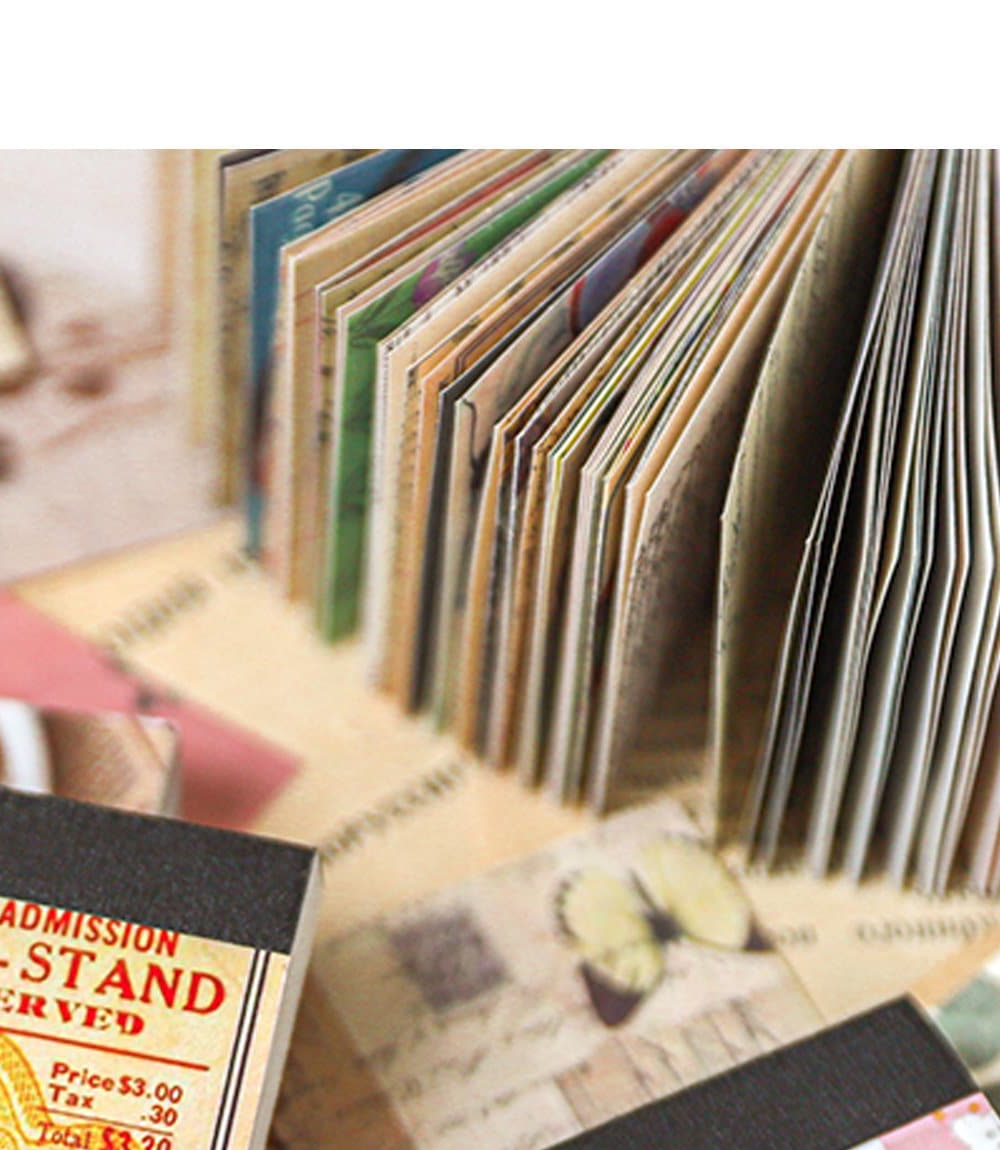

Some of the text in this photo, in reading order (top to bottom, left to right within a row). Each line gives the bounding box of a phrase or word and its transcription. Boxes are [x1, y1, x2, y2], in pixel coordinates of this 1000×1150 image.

[51, 1061, 183, 1104] Price $3.00
[48, 1083, 178, 1127] Tax .30
[37, 1120, 92, 1150] Total
